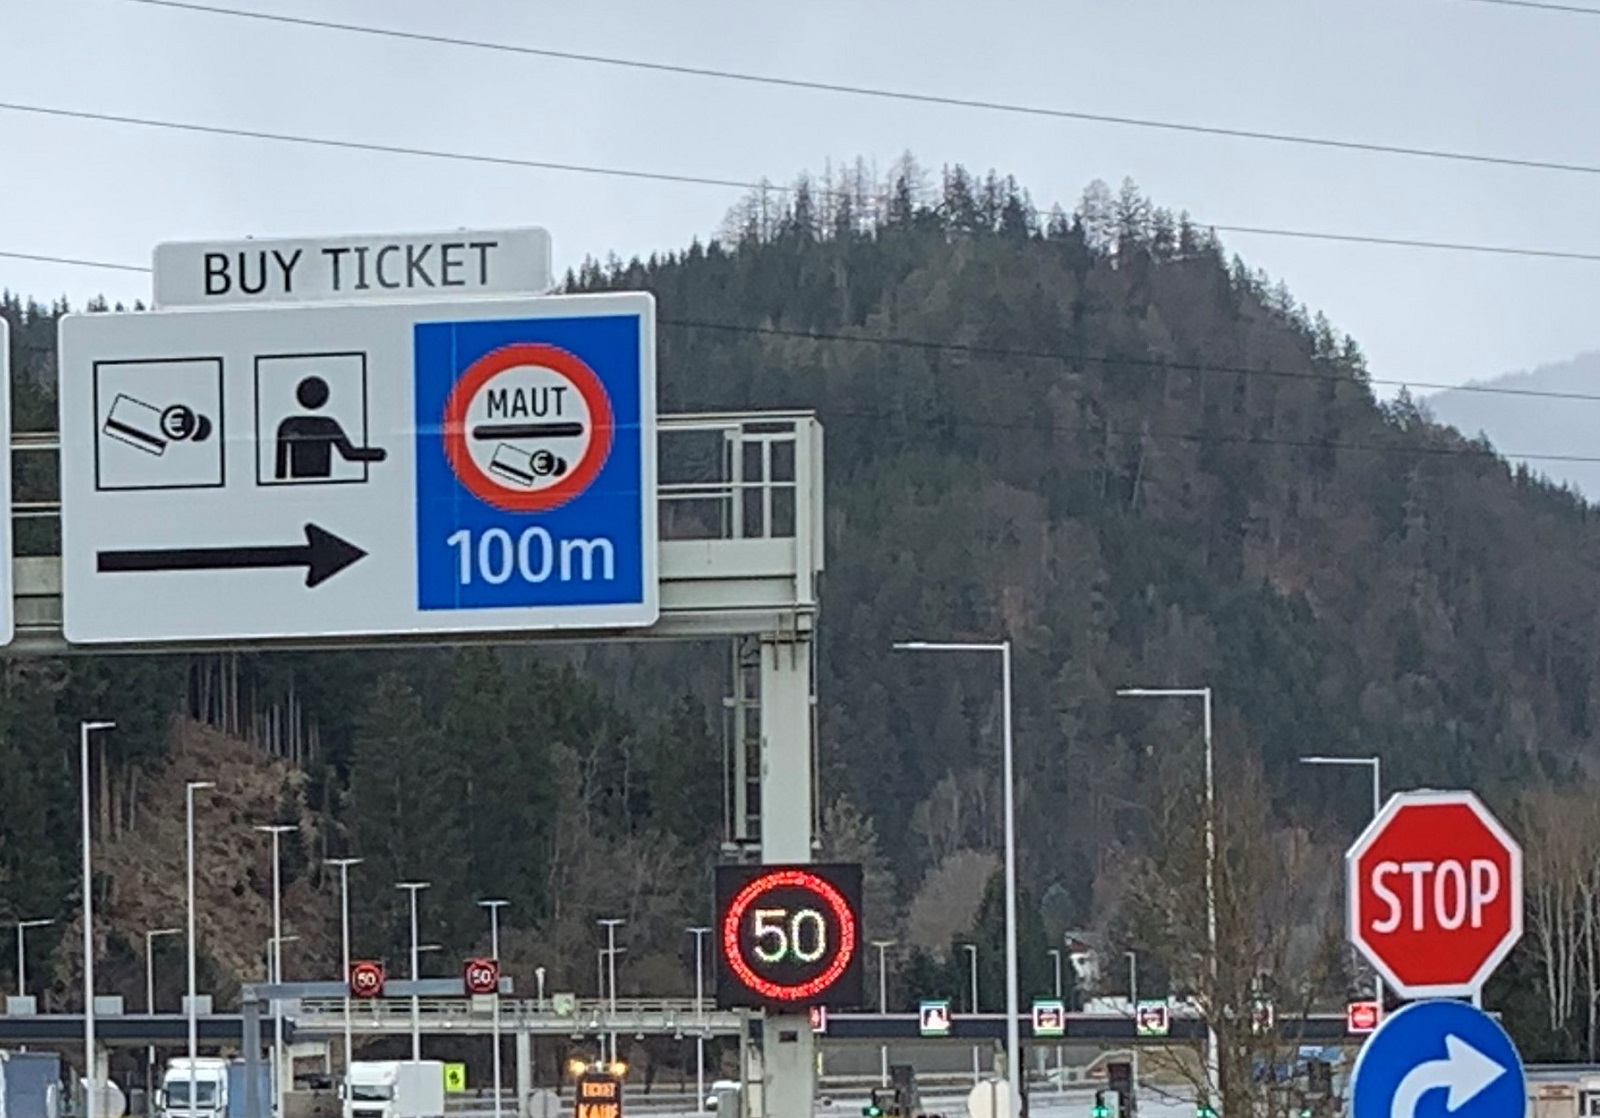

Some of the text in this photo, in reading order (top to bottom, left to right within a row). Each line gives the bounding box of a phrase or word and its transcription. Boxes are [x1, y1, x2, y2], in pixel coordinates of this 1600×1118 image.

[204, 242, 498, 295] BUY TICKET
[487, 387, 567, 418] MAUT
[447, 526, 614, 585] 100m
[1372, 859, 1500, 933] STOP
[753, 909, 826, 962] 50
[357, 973, 376, 986] 50
[472, 969, 491, 984] 50
